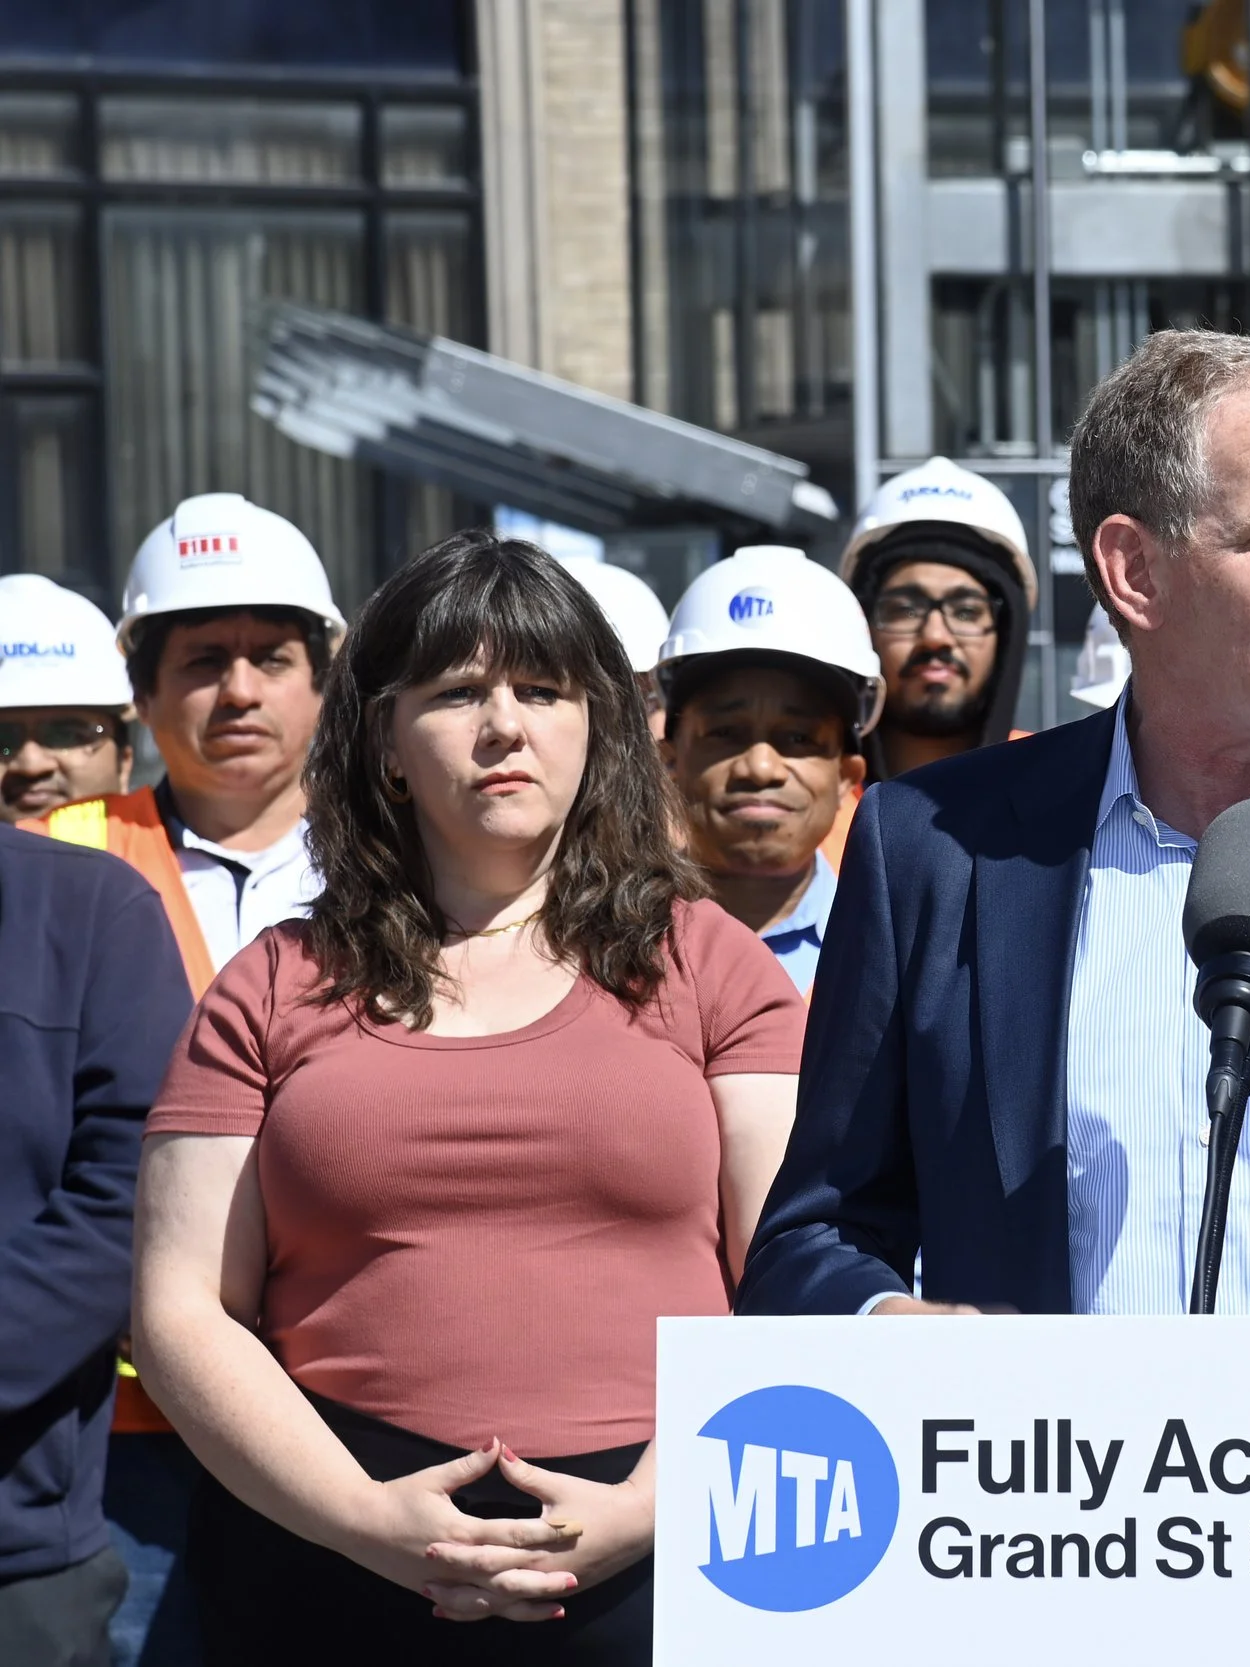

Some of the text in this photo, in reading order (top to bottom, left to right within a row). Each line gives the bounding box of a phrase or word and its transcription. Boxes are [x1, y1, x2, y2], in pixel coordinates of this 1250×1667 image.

[728, 594, 774, 621] MTA
[0, 641, 76, 658] UDLAU
[921, 1418, 1124, 1511] Fully
[697, 1434, 864, 1567] MTA
[918, 1516, 1137, 1580] Grand
[1155, 1516, 1232, 1580] St
